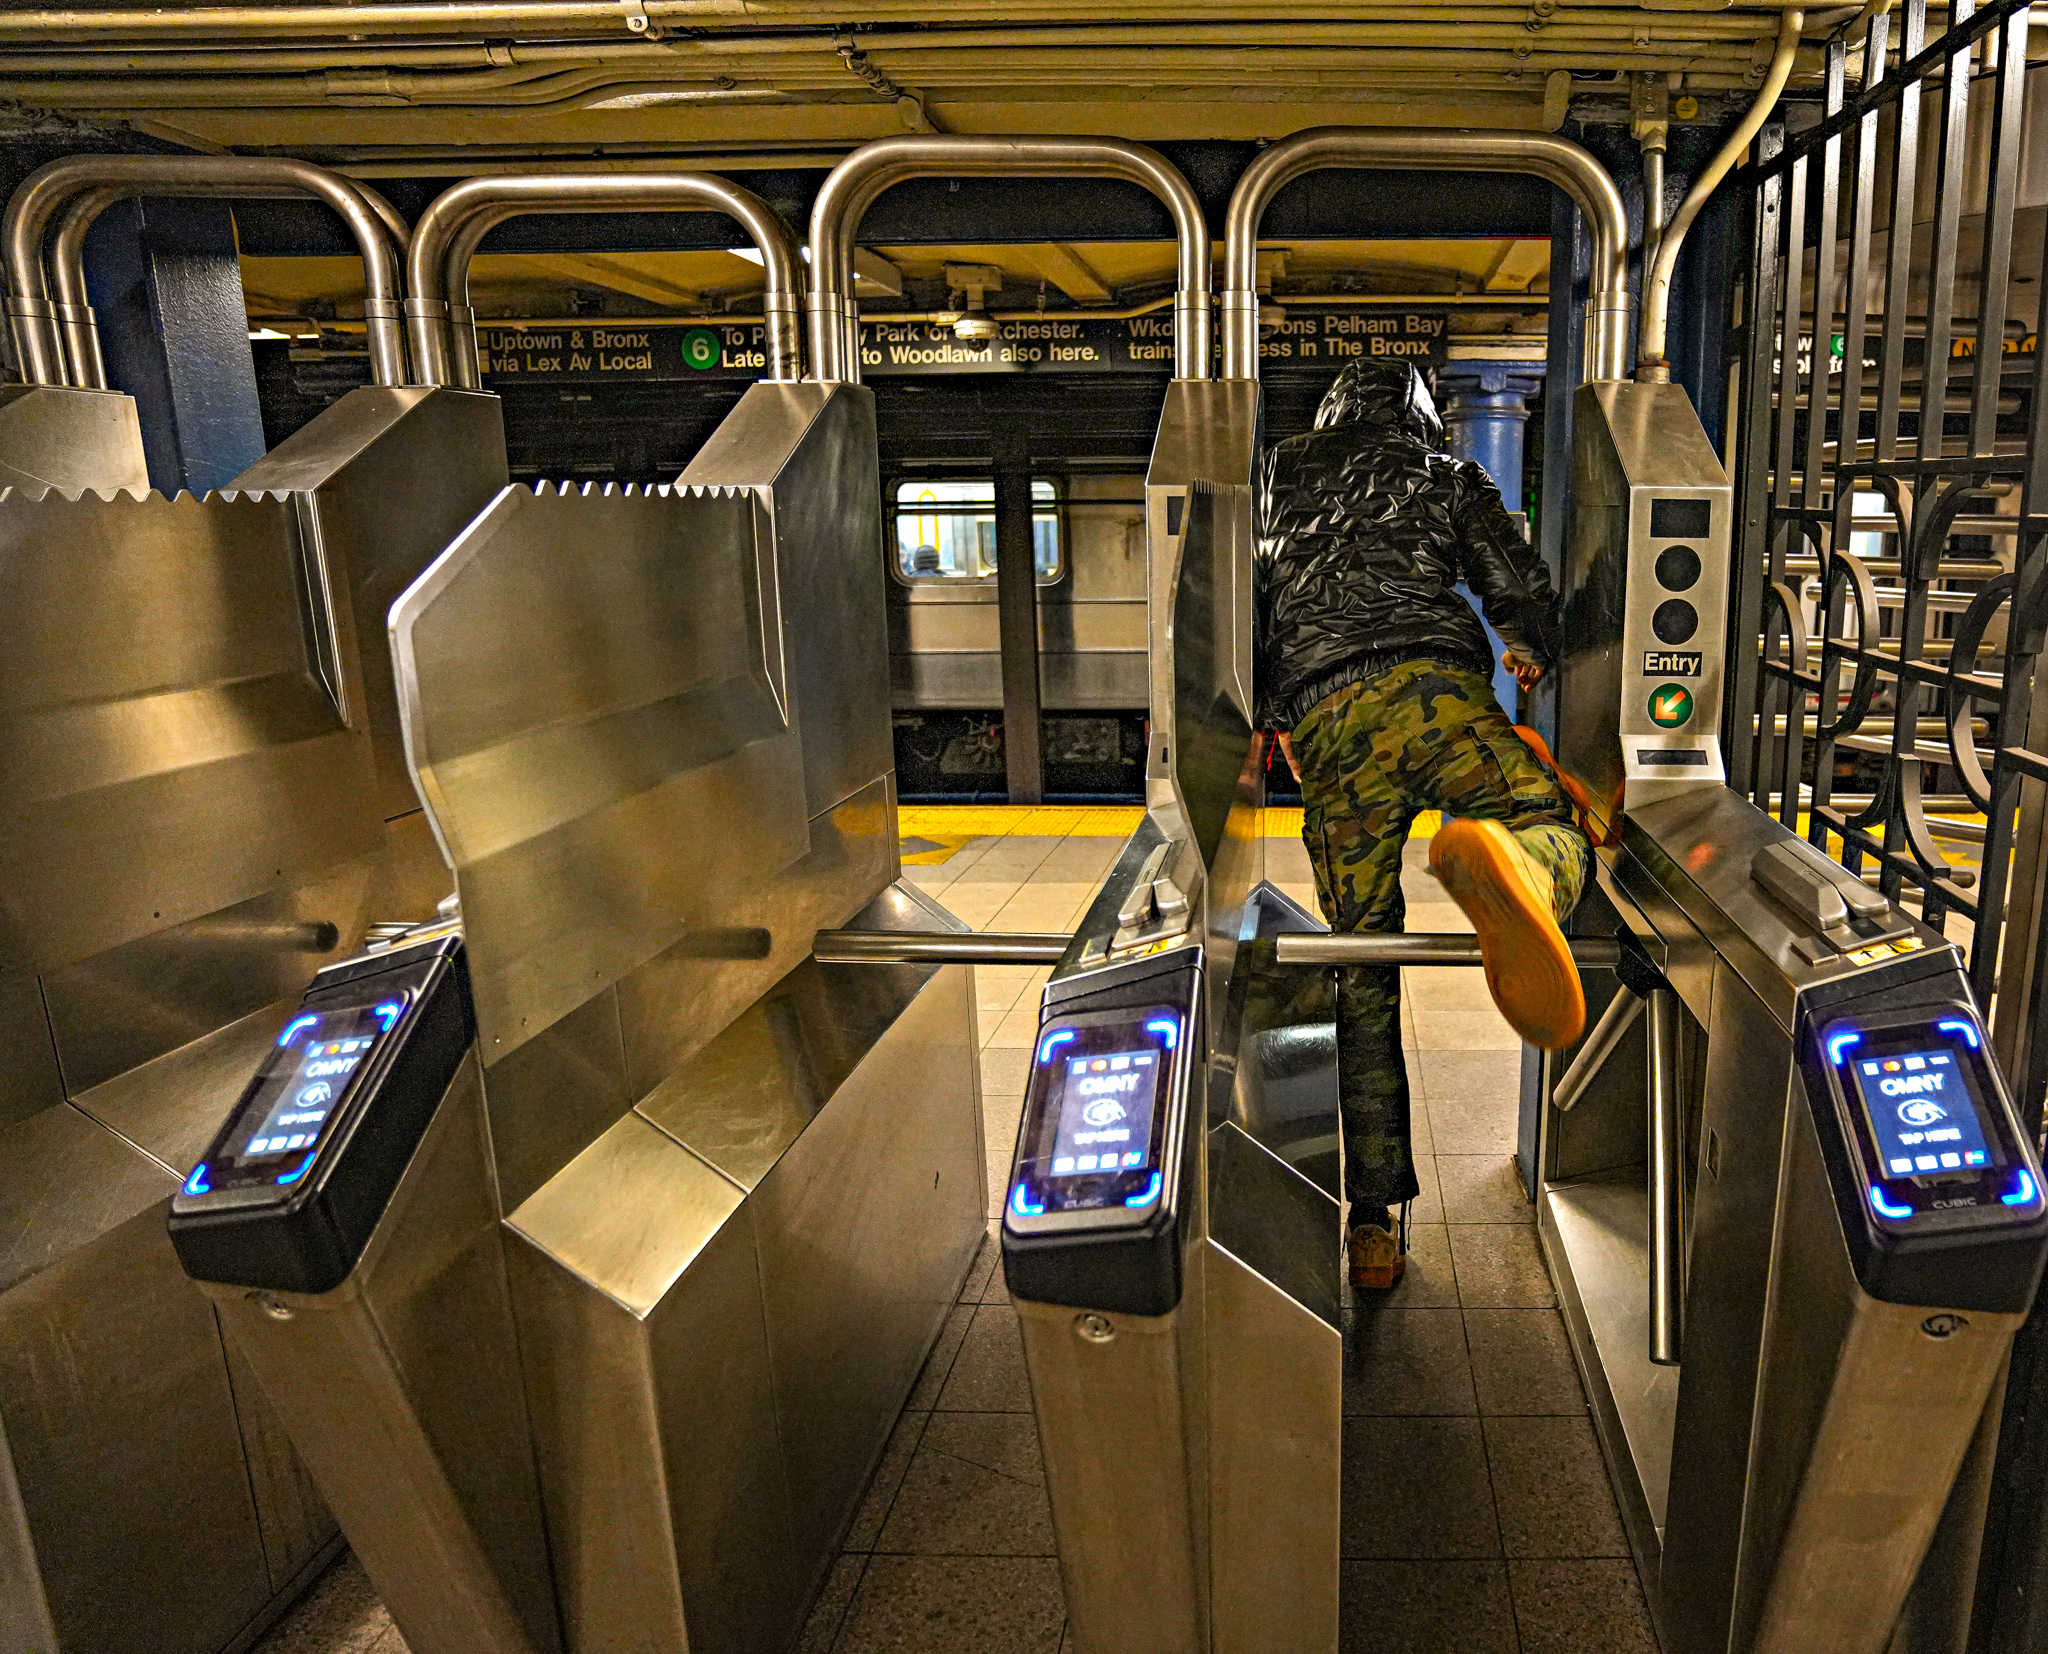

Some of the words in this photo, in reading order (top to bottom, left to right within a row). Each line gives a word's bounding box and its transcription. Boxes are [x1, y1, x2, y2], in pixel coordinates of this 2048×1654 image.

[721, 327, 745, 346] To
[877, 323, 919, 343] Park
[929, 325, 949, 342] or
[997, 321, 1085, 339] chester.
[1325, 315, 1398, 334] Pelham
[1405, 315, 1444, 337] Bay
[490, 331, 563, 354] Uptown
[570, 330, 584, 349] &
[592, 330, 650, 348] Bronx
[692, 338, 710, 361] 6
[1301, 339, 1317, 356] in
[1325, 338, 1363, 356] The
[1371, 337, 1430, 356] Bronx
[492, 354, 519, 373] via
[527, 353, 562, 371] Lex
[569, 352, 592, 371] Av
[600, 351, 652, 371] Local
[722, 350, 766, 368] Late
[862, 347, 882, 364] to
[890, 345, 993, 364] Woodlawn
[1000, 343, 1042, 362] also
[1050, 342, 1100, 362] here.
[1644, 653, 1700, 676] Entry
[1880, 1073, 1944, 1097] OMNY
[1932, 1196, 1977, 1211] CUBIC
